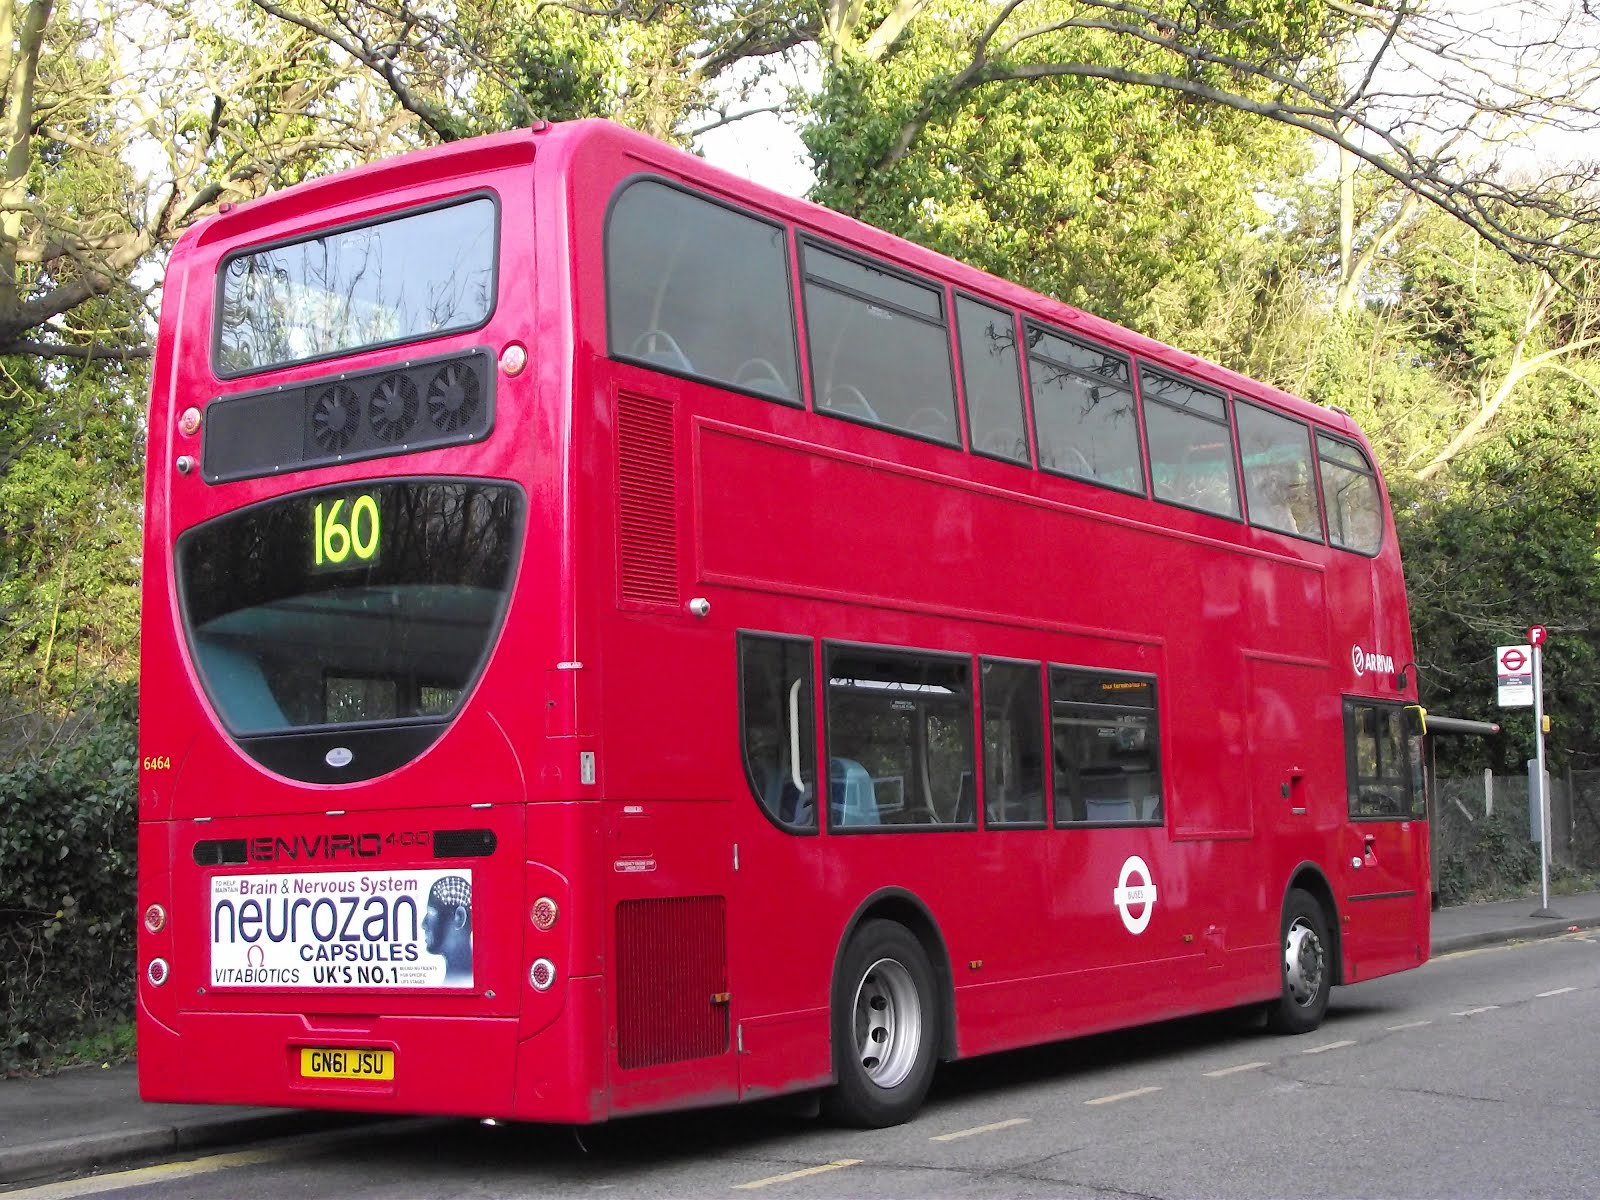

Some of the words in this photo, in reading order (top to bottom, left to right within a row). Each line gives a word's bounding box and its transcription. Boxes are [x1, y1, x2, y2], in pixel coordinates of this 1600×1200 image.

[315, 494, 380, 566] 160
[1532, 628, 1541, 643] F
[1365, 652, 1395, 673] ARRIVA
[143, 756, 171, 770] 6464
[250, 833, 382, 861] ENVIRO
[240, 879, 277, 895] Brain
[280, 878, 290, 894] &
[293, 878, 355, 894] Nervous
[360, 876, 418, 895] System
[1127, 890, 1144, 900] BUSES
[214, 894, 418, 943] neurozan
[299, 943, 419, 962] CAPSULES
[214, 968, 300, 983] VITABIOTICS
[313, 965, 353, 984] UK'S
[357, 965, 398, 984] NO.1
[311, 1052, 347, 1073] GN61
[352, 1053, 384, 1075] JSU
